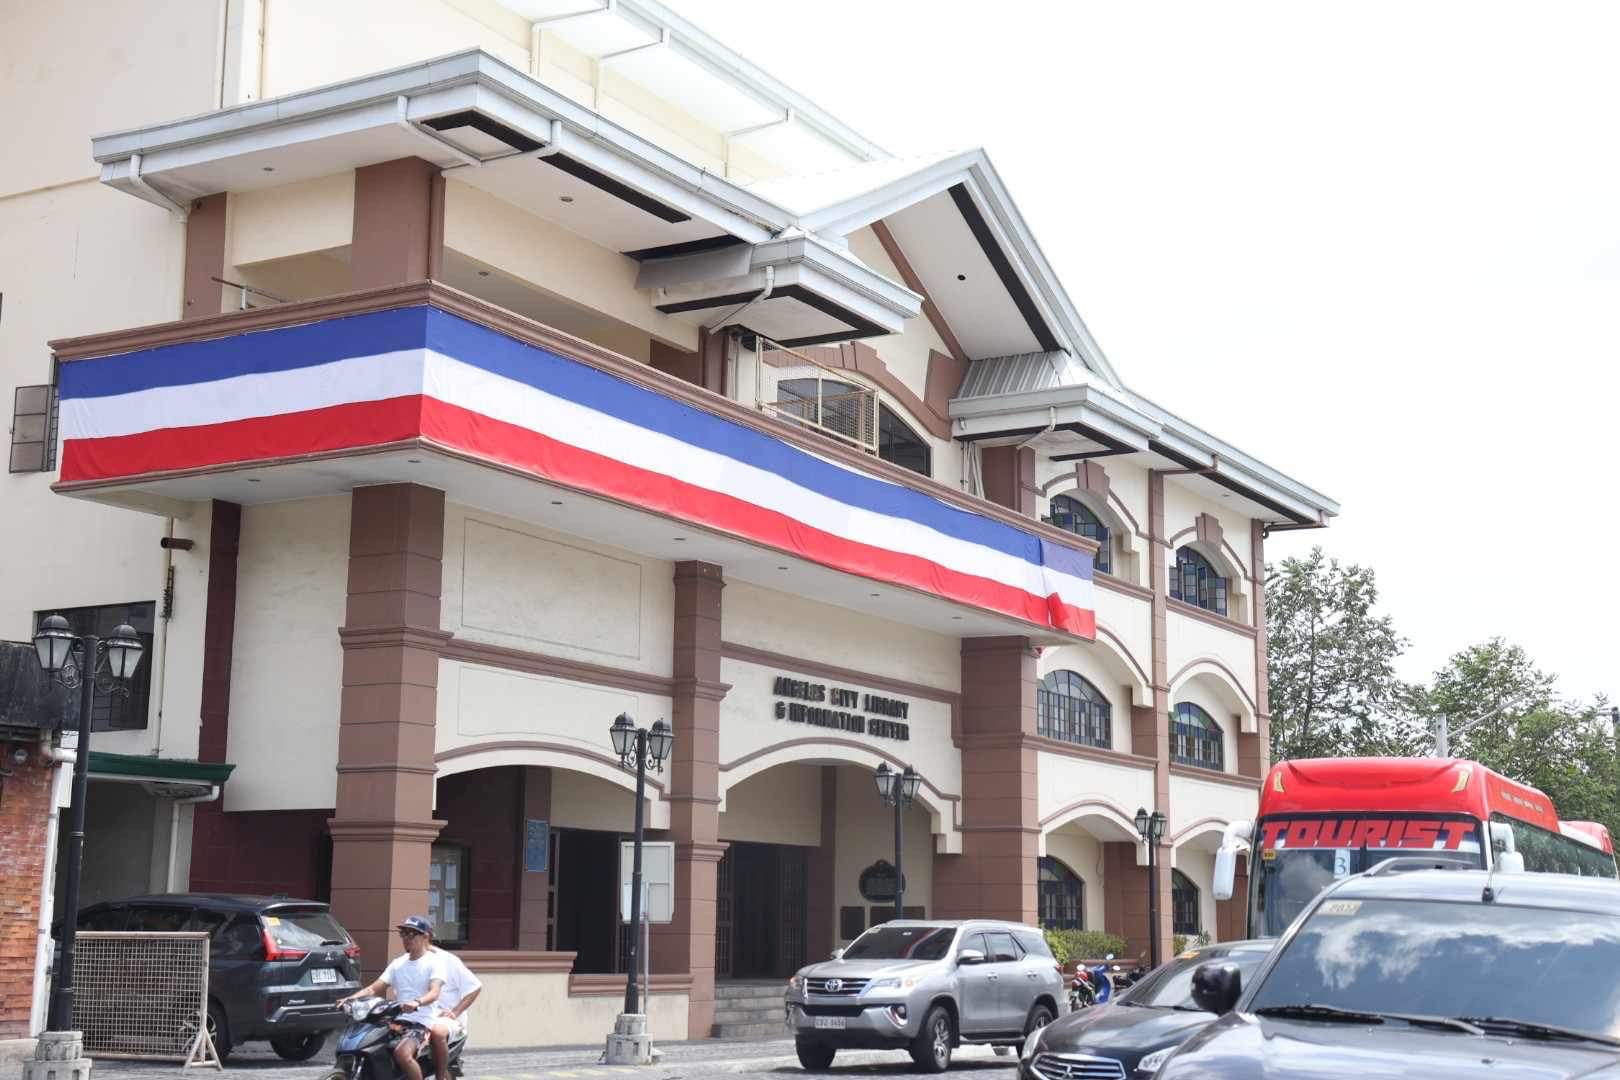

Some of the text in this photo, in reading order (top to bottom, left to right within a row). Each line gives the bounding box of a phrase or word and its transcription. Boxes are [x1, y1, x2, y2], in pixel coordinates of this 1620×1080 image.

[789, 702, 865, 733] INFORMATION
[830, 687, 859, 709] CITY
[864, 694, 909, 719] LIBRARY
[1262, 818, 1475, 849] TOURIST
